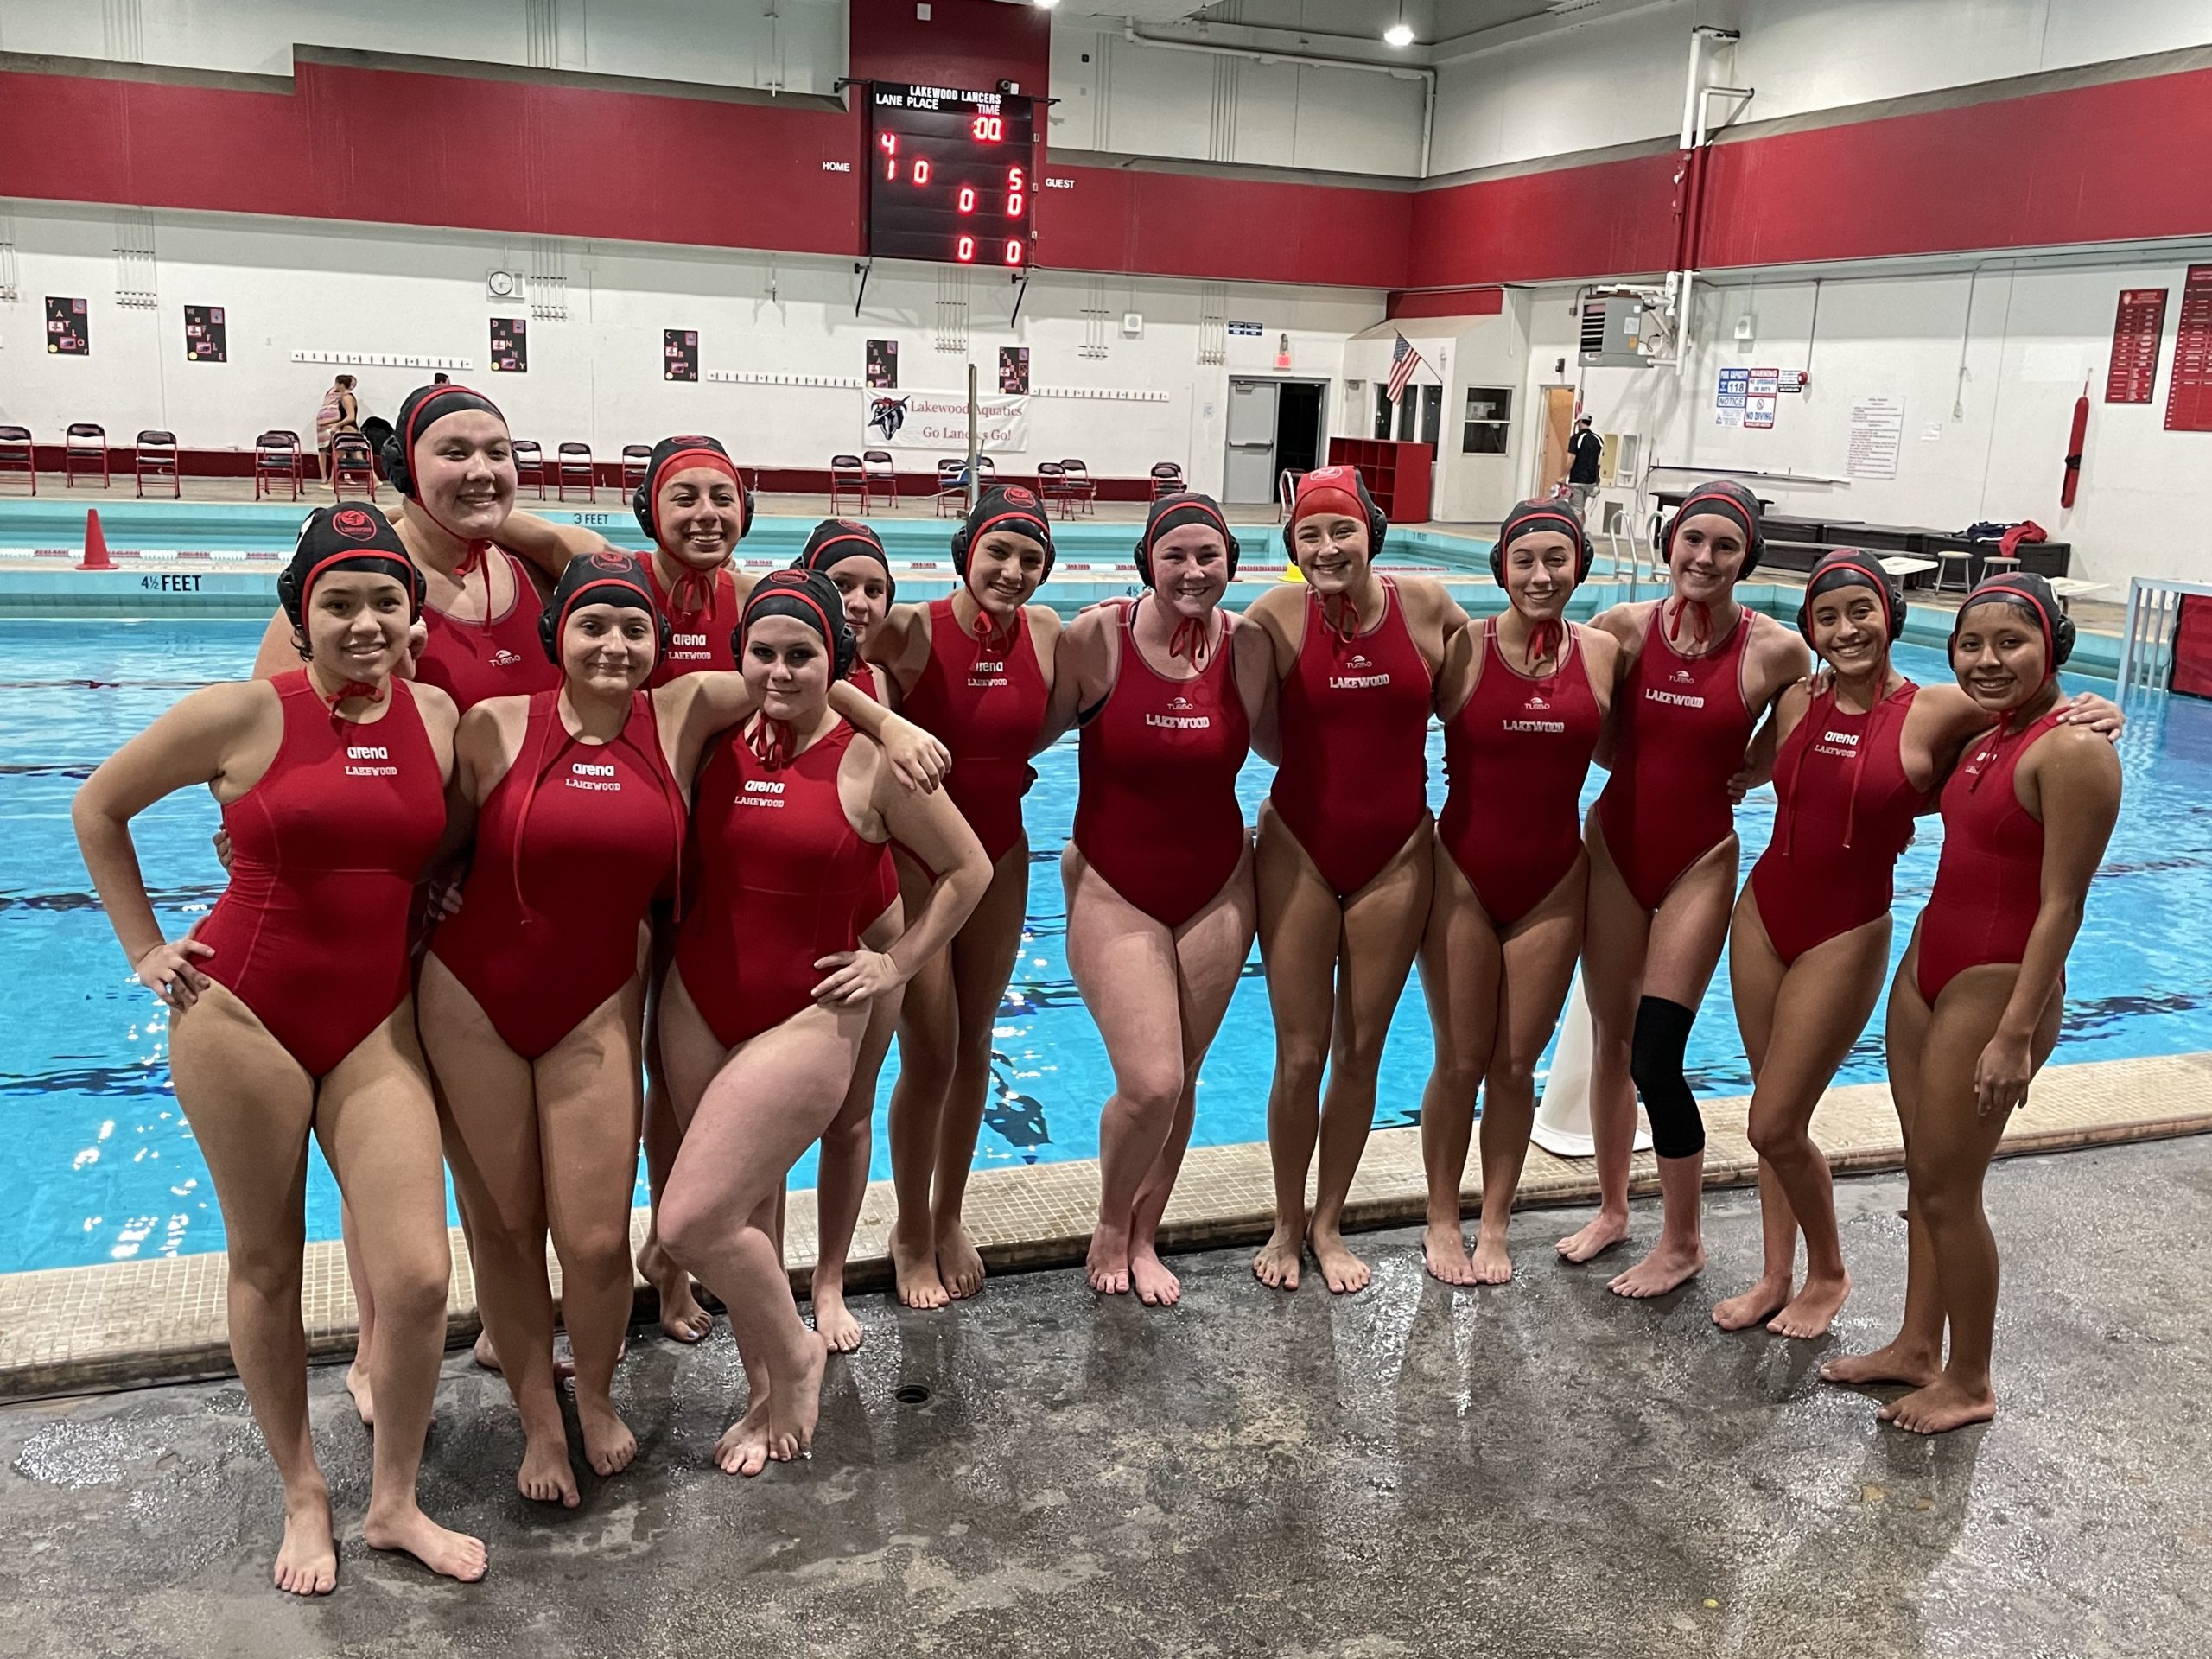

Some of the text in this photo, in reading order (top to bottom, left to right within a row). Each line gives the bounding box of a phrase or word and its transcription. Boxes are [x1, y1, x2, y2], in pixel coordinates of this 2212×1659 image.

[876, 93, 938, 110] LANE PLACE
[910, 86, 1001, 105] LAKEWOOD LANCERS
[976, 104, 1000, 115] TIME
[881, 134, 895, 155] 4
[823, 162, 850, 172] HOME
[914, 160, 929, 183] 0
[1046, 178, 1075, 188] GUEST
[960, 189, 1022, 215] 0 0
[958, 238, 1020, 264] 0 0
[1729, 383, 1745, 392] 118
[1719, 397, 1744, 406] NOTICE
[1755, 412, 1772, 421] DIVING
[923, 427, 1011, 441] Go Lancs Go!
[574, 513, 608, 524] 3 FEET
[162, 575, 201, 591] FEET
[673, 633, 706, 646] arena
[1330, 674, 1390, 688] LAKEWOOD
[1645, 688, 1704, 708] LAKEWOOD
[1146, 714, 1210, 728] LAKEWOOD
[1503, 720, 1565, 733] LAKEWOOD
[1824, 731, 1859, 746] arena
[347, 747, 388, 759] arena
[1815, 745, 1857, 758] LAKEWOOD
[345, 766, 397, 776] LAKEWOOD
[572, 763, 614, 776] arena
[566, 779, 621, 791] LAKEWOOD
[744, 780, 785, 793] arena
[734, 796, 785, 807] LAKEWOOD
